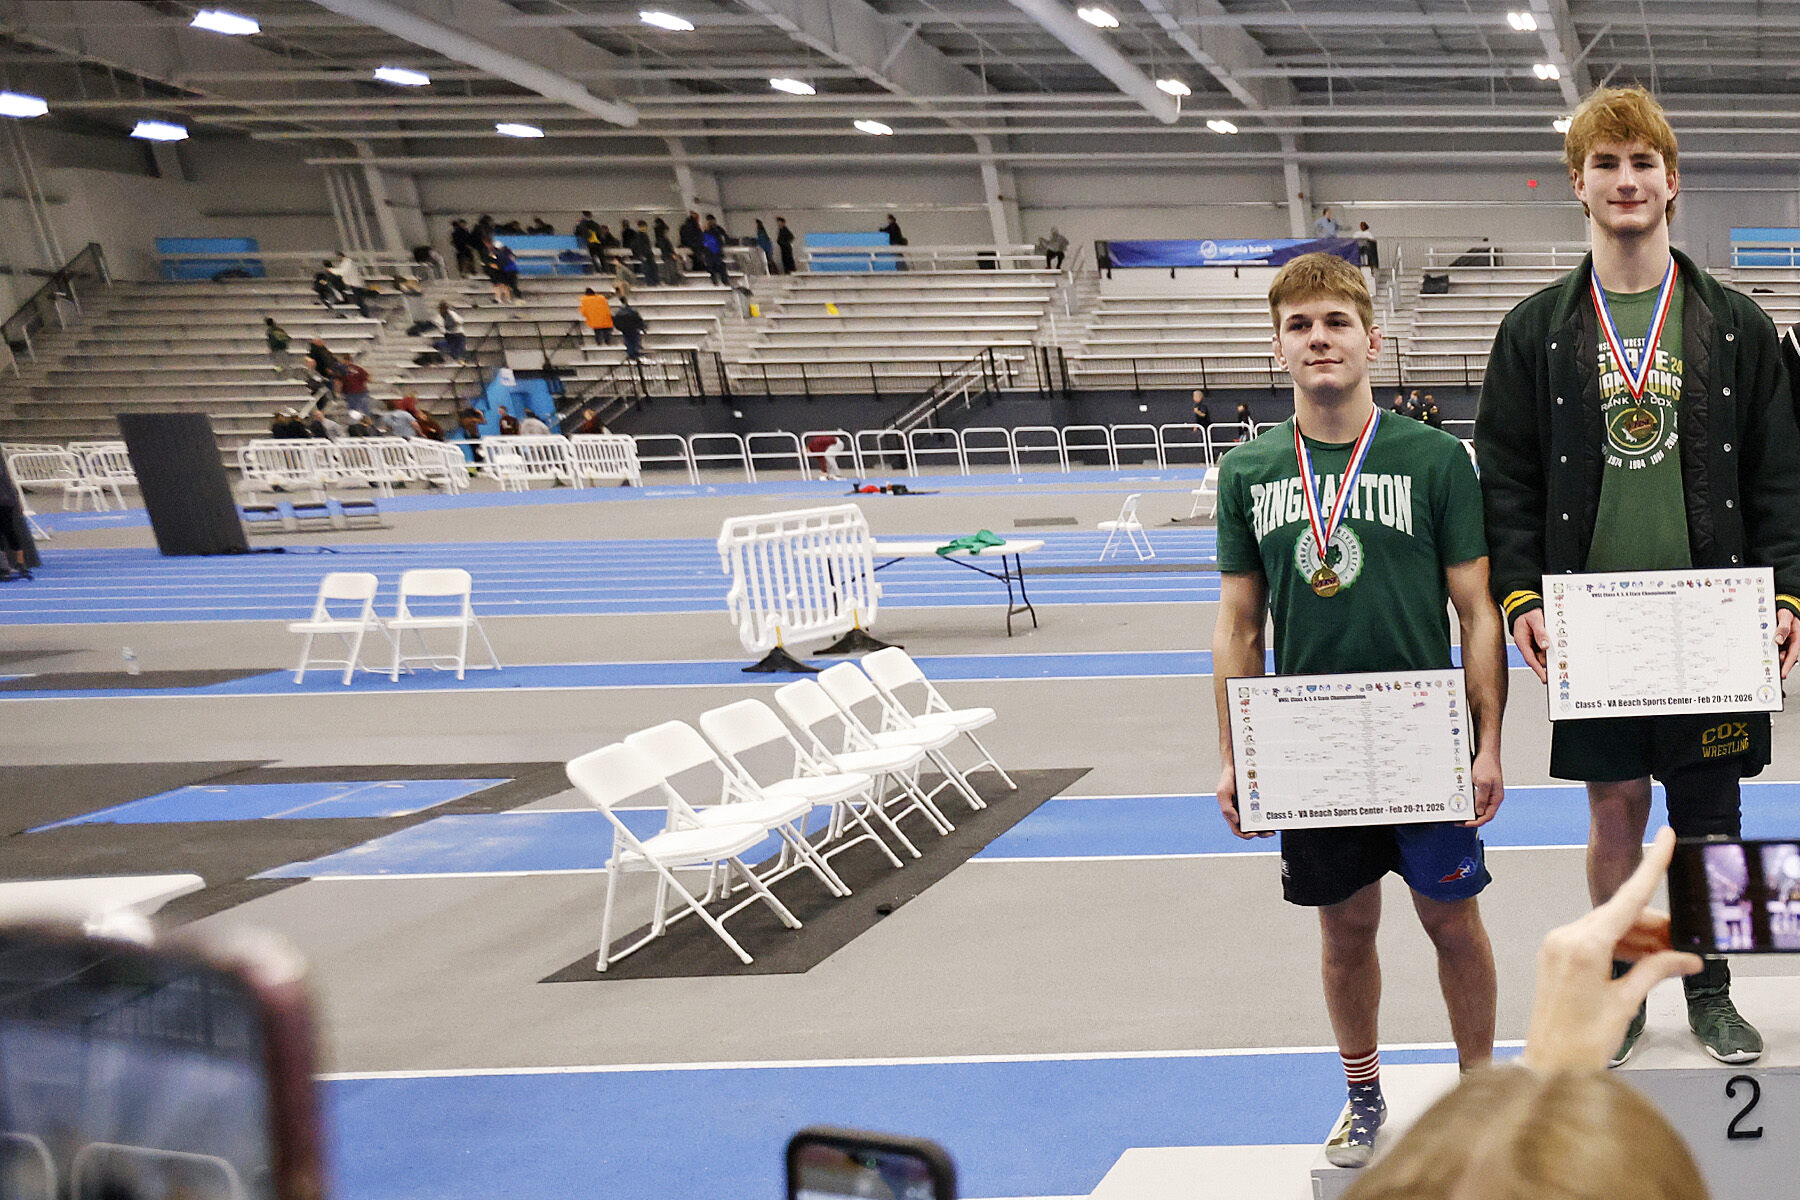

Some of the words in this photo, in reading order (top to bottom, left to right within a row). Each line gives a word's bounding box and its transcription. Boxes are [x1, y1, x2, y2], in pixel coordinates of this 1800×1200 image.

[1597, 348, 1669, 374] STAE
[1671, 357, 1683, 375] 24
[1601, 397, 1629, 411] RANK
[1650, 397, 1672, 408] COX
[1575, 700, 1596, 709] Class
[1597, 699, 1601, 708] 5
[1618, 698, 1641, 707] Beach
[1642, 697, 1666, 707] Sports
[1668, 696, 1692, 705] Center
[1698, 695, 1710, 704] Feb
[1734, 694, 1753, 702] 2026
[1702, 722, 1749, 745] COX
[1703, 737, 1749, 758] WRESTLING
[1266, 811, 1287, 820] Class
[1288, 810, 1293, 819] 5
[1309, 808, 1333, 818] Beach
[1334, 807, 1358, 817] Sports
[1359, 806, 1384, 816] Center
[1389, 805, 1402, 814] Feb
[1426, 802, 1445, 812] 2026
[1725, 1075, 1763, 1139] 2
